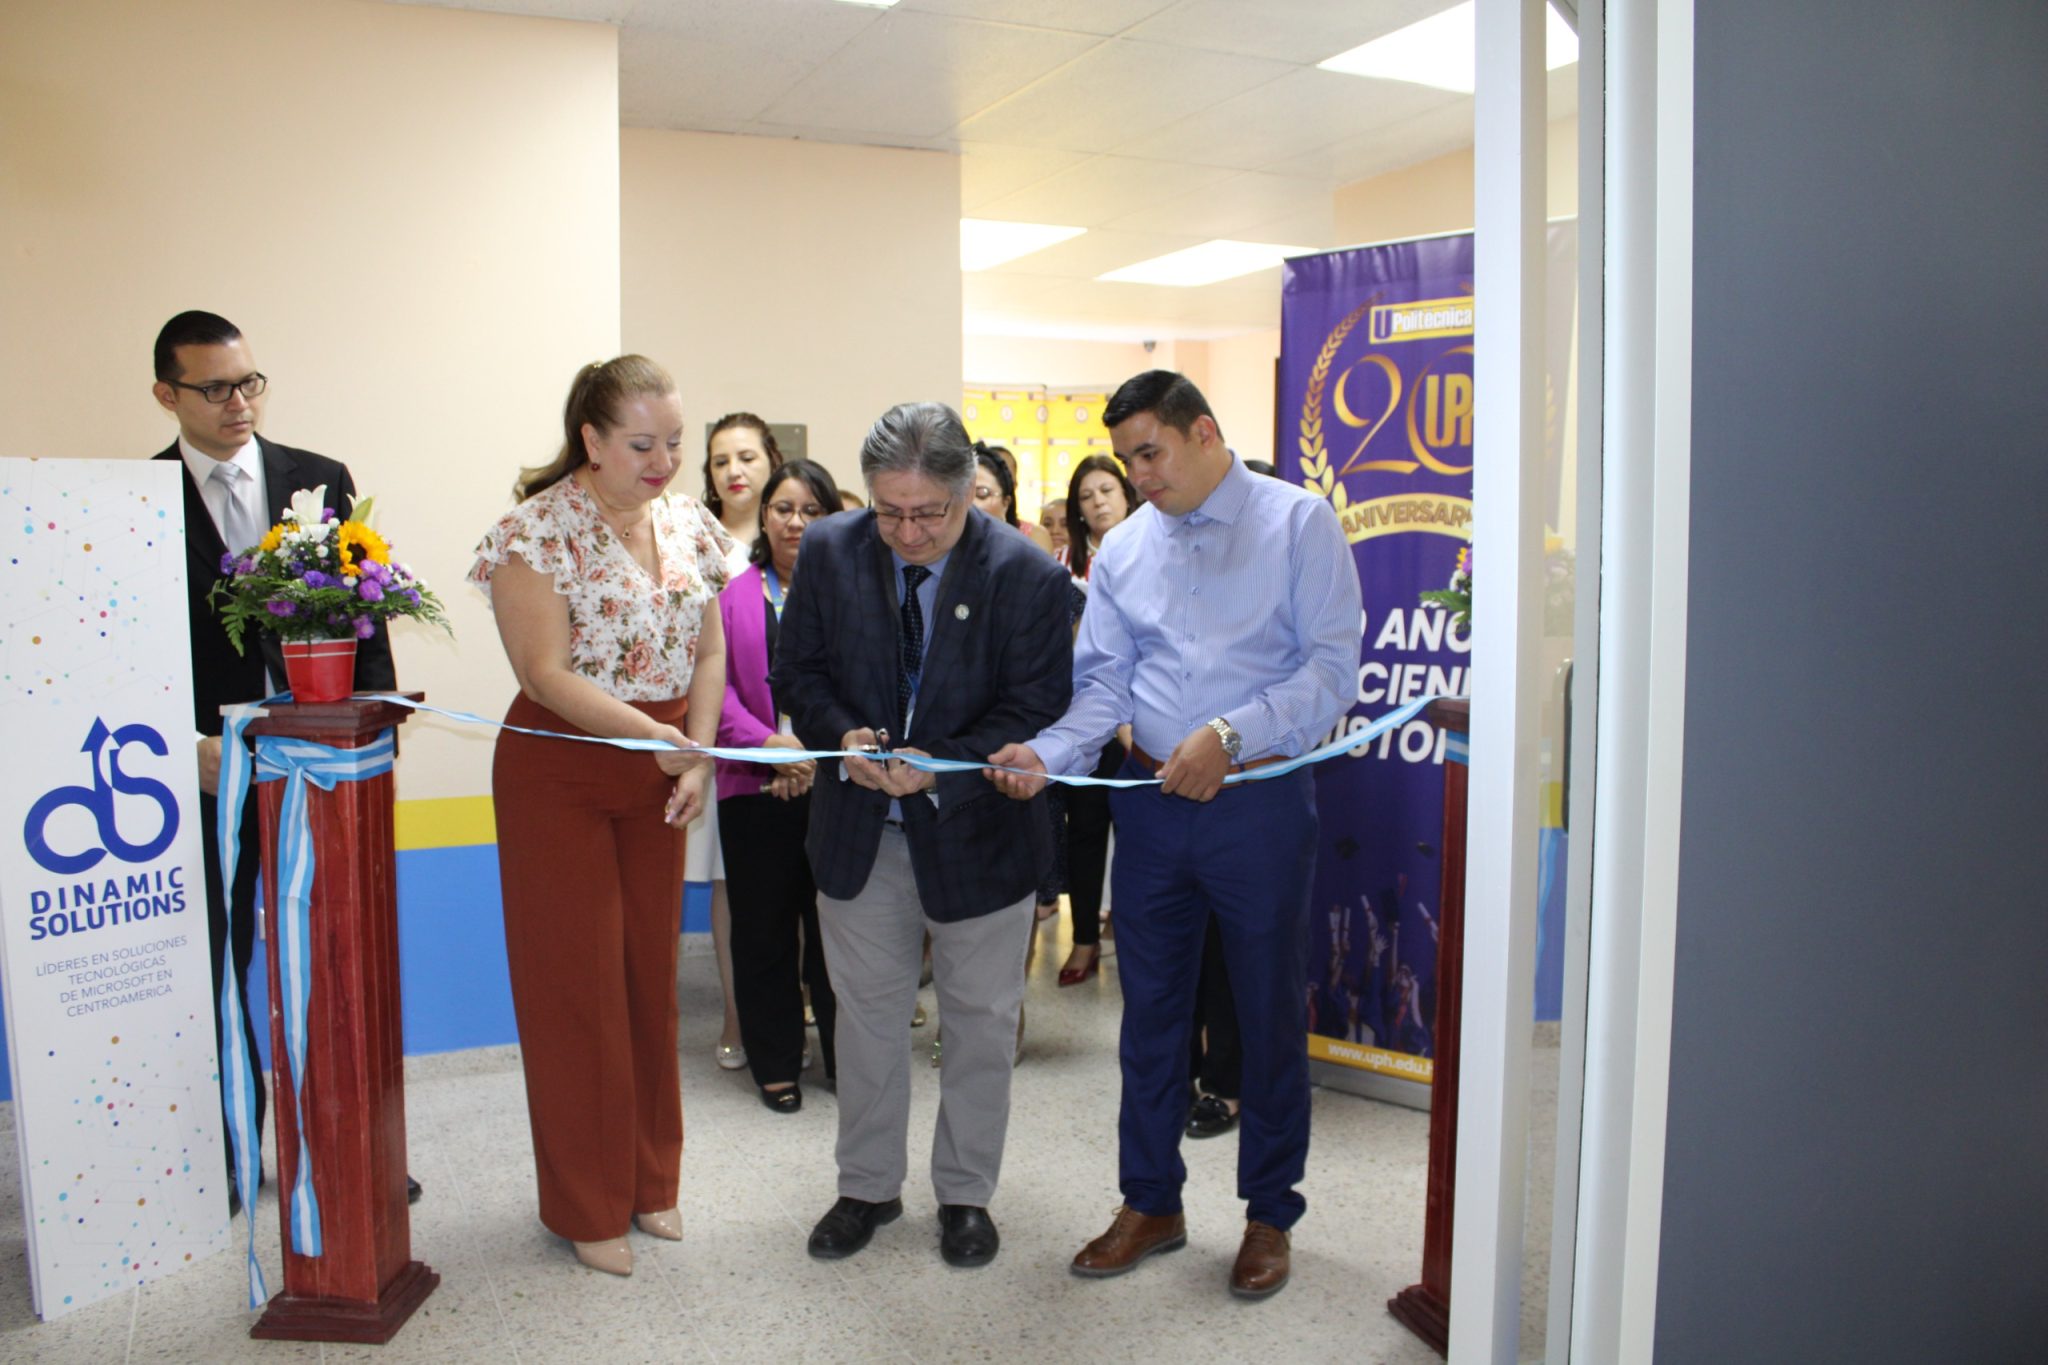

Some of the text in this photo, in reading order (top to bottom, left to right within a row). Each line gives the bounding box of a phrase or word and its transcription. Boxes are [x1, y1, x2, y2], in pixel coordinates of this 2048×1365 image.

[30, 866, 184, 914] DINAMIC
[29, 890, 186, 940] SOLUTIONS
[36, 935, 188, 977] LÍDERES EN SOLUCIONES
[68, 955, 167, 986] TECNOLÓGICAS
[60, 968, 173, 1004] DE MICROSOFT EN
[66, 984, 173, 1018] CENTROAMERICA
